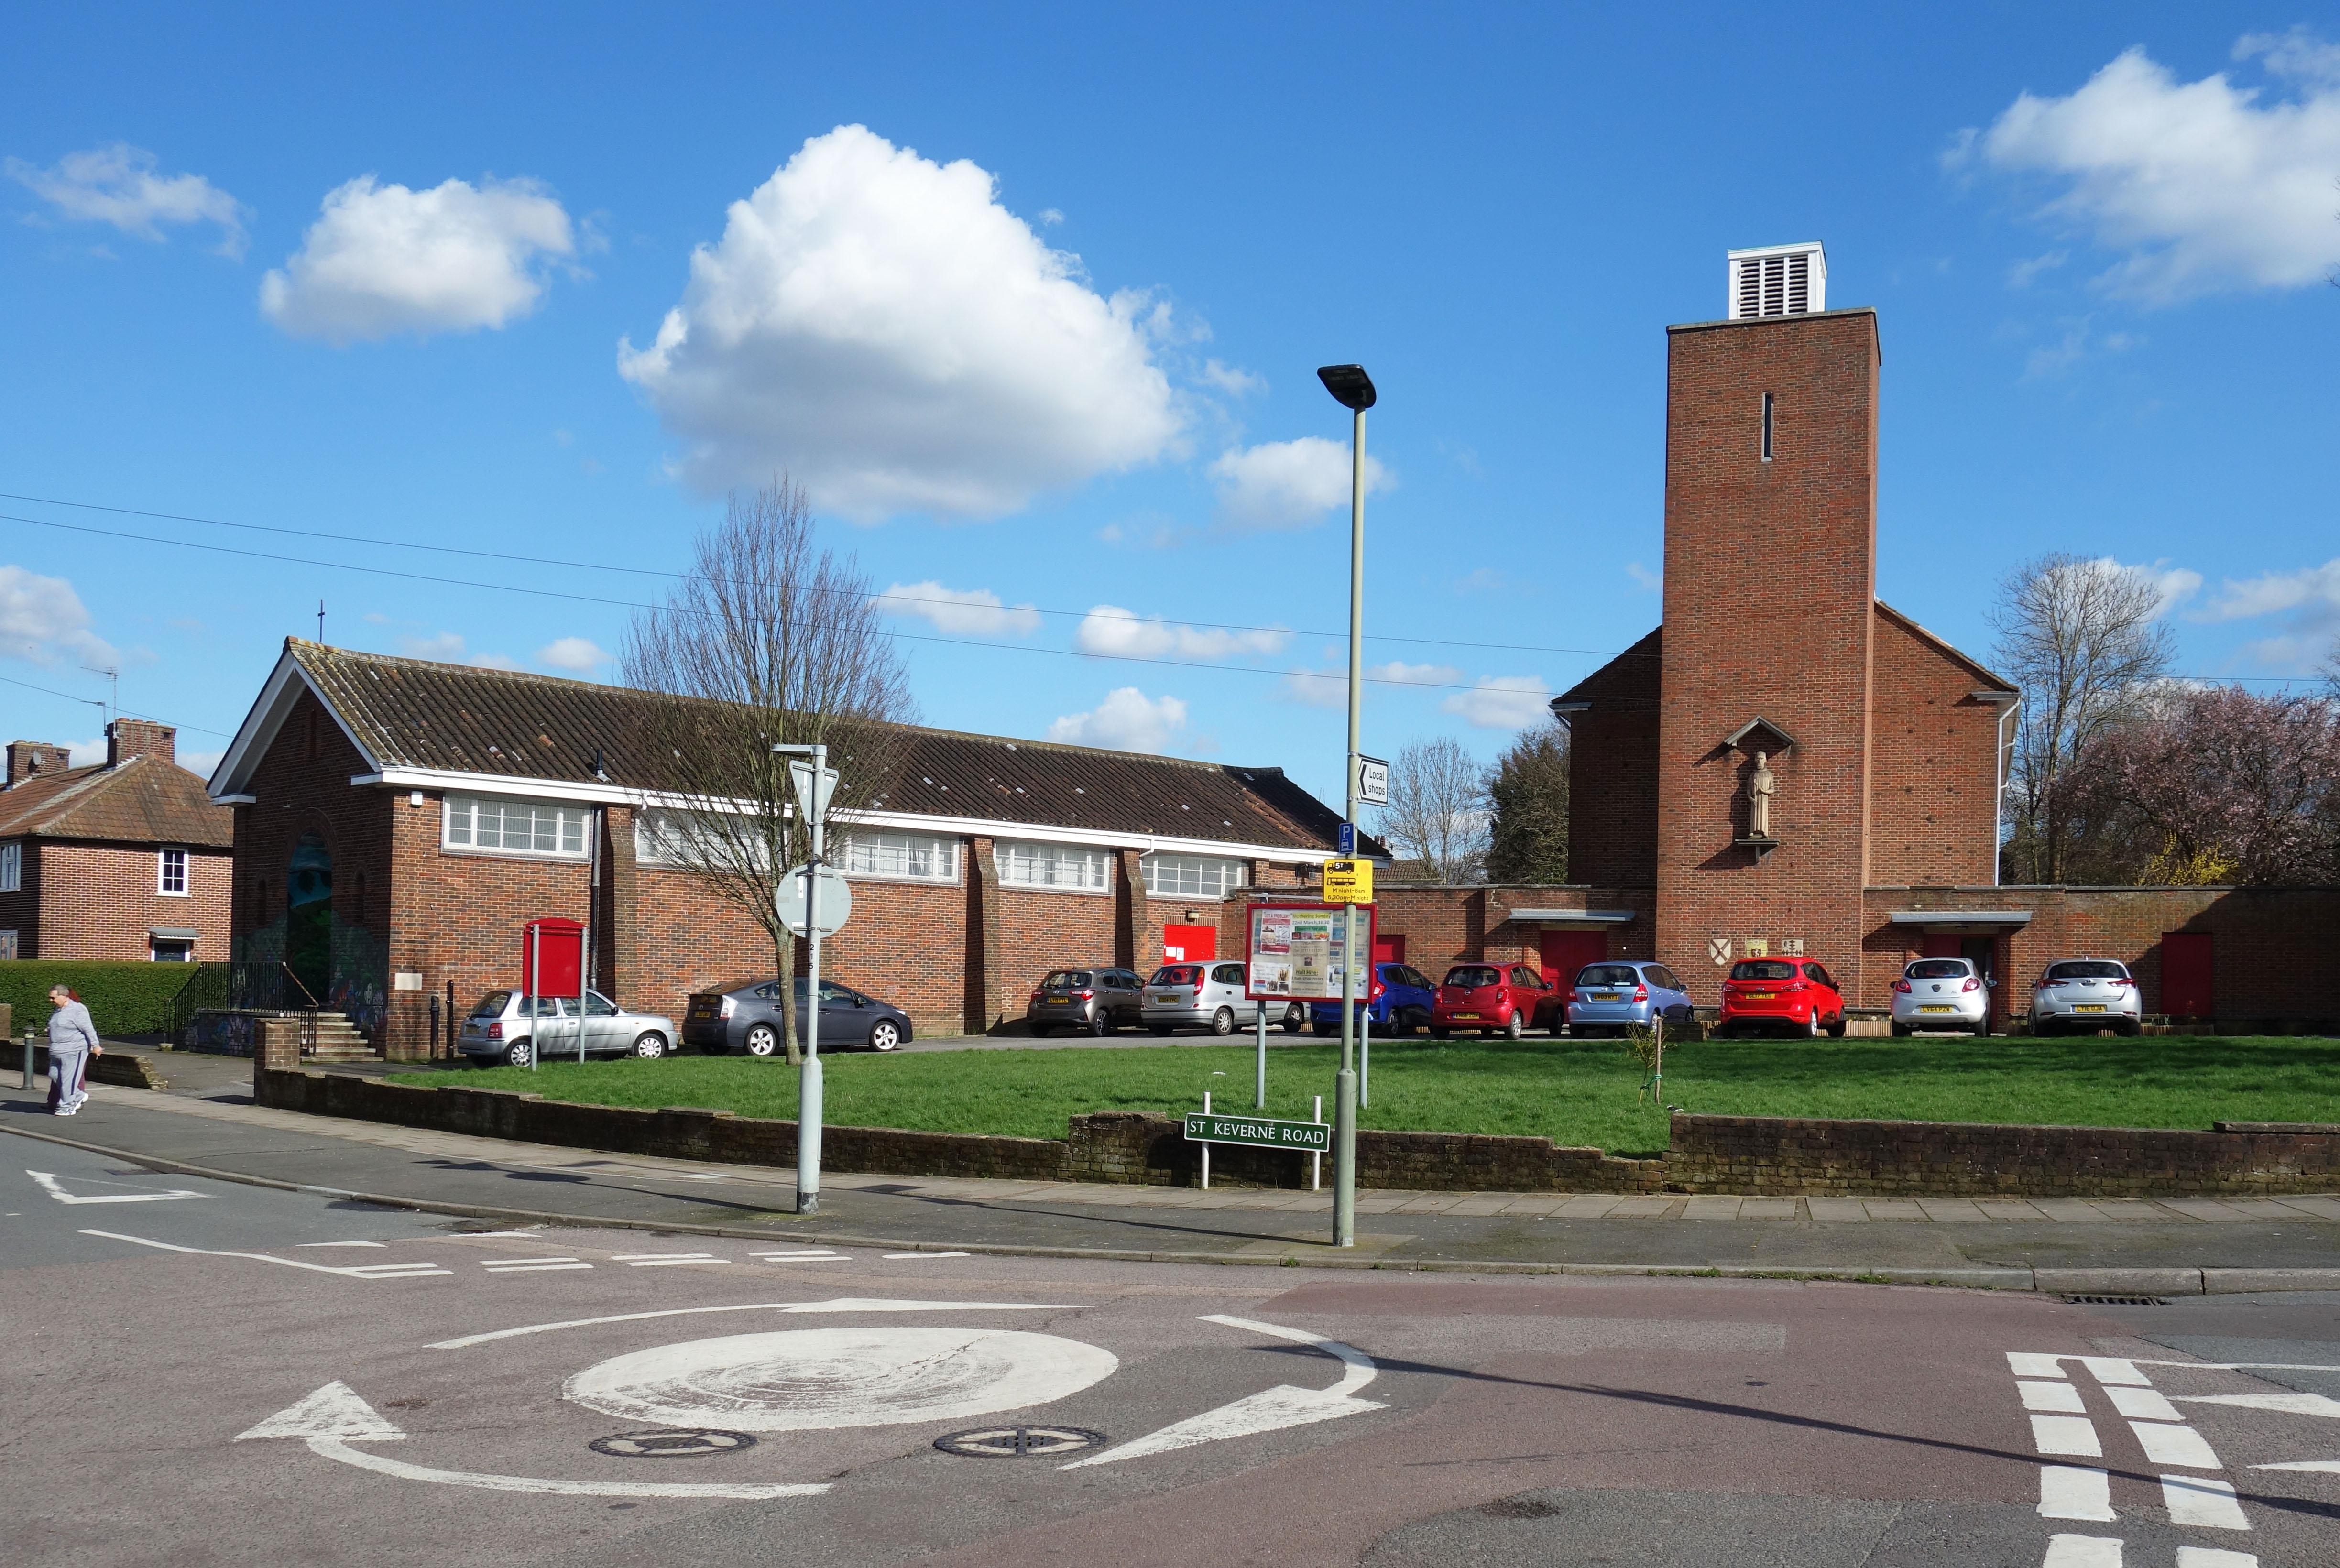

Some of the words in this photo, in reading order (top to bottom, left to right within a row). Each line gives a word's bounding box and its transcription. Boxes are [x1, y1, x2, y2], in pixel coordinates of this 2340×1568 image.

[1369, 768, 1385, 782] Local
[1368, 782, 1385, 796] shops
[1343, 826, 1350, 838] P
[1190, 1121, 1206, 1133] ST
[1214, 1122, 1276, 1140] KEVERNE
[1282, 1128, 1324, 1144] ROAD
